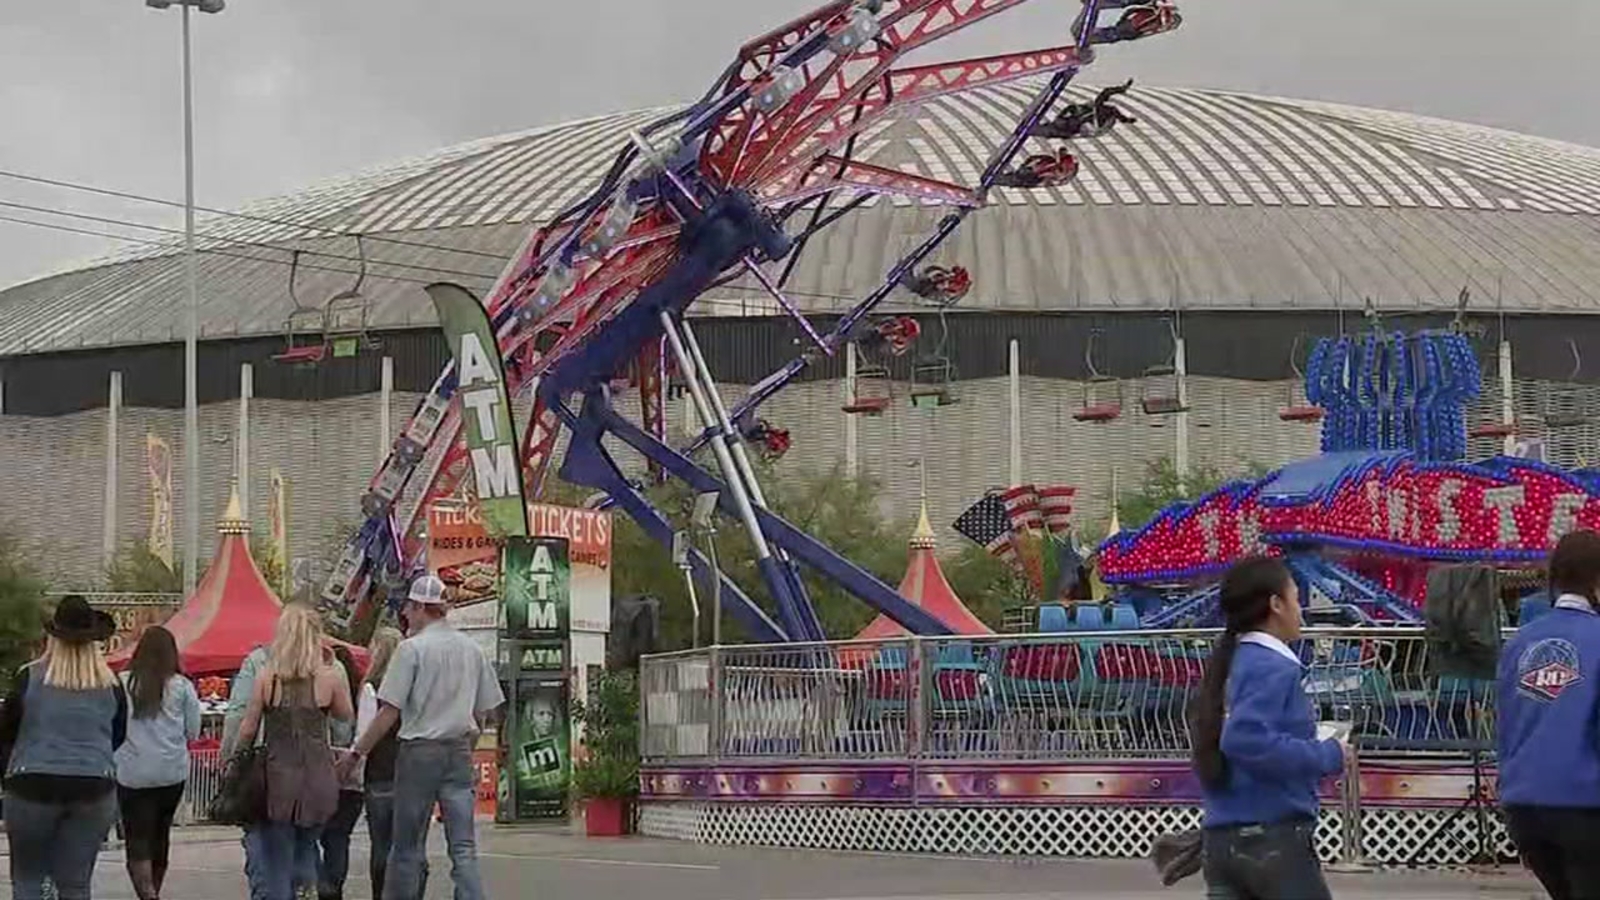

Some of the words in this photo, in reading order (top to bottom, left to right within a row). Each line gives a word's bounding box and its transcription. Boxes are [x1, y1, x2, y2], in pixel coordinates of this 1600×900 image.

[459, 333, 520, 499] ATM
[528, 504, 608, 546] TICKETS
[528, 545, 557, 629] ATM
[521, 649, 562, 665] ATM
